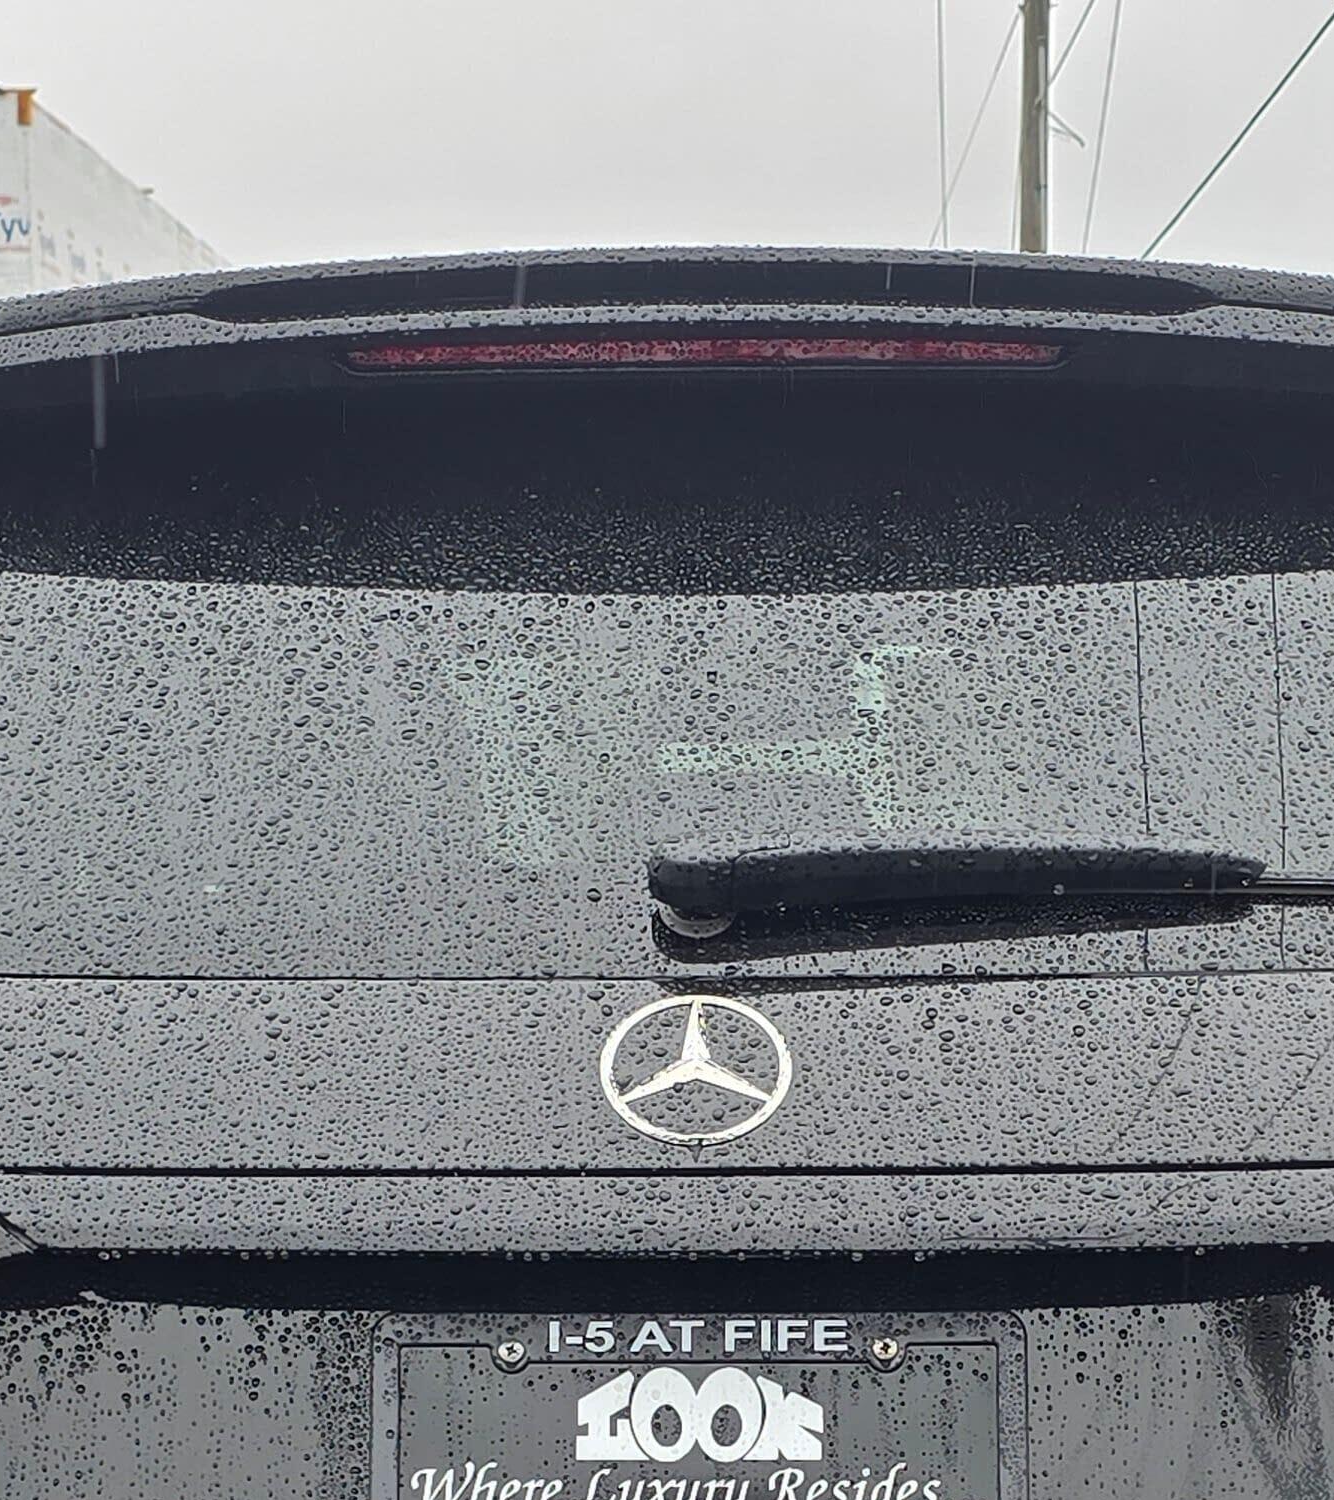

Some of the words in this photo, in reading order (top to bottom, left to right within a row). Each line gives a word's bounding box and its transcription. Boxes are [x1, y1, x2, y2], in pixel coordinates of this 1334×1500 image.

[548, 1320, 616, 1353] I-5
[629, 1320, 705, 1353] AT
[724, 1319, 849, 1353] FIFE
